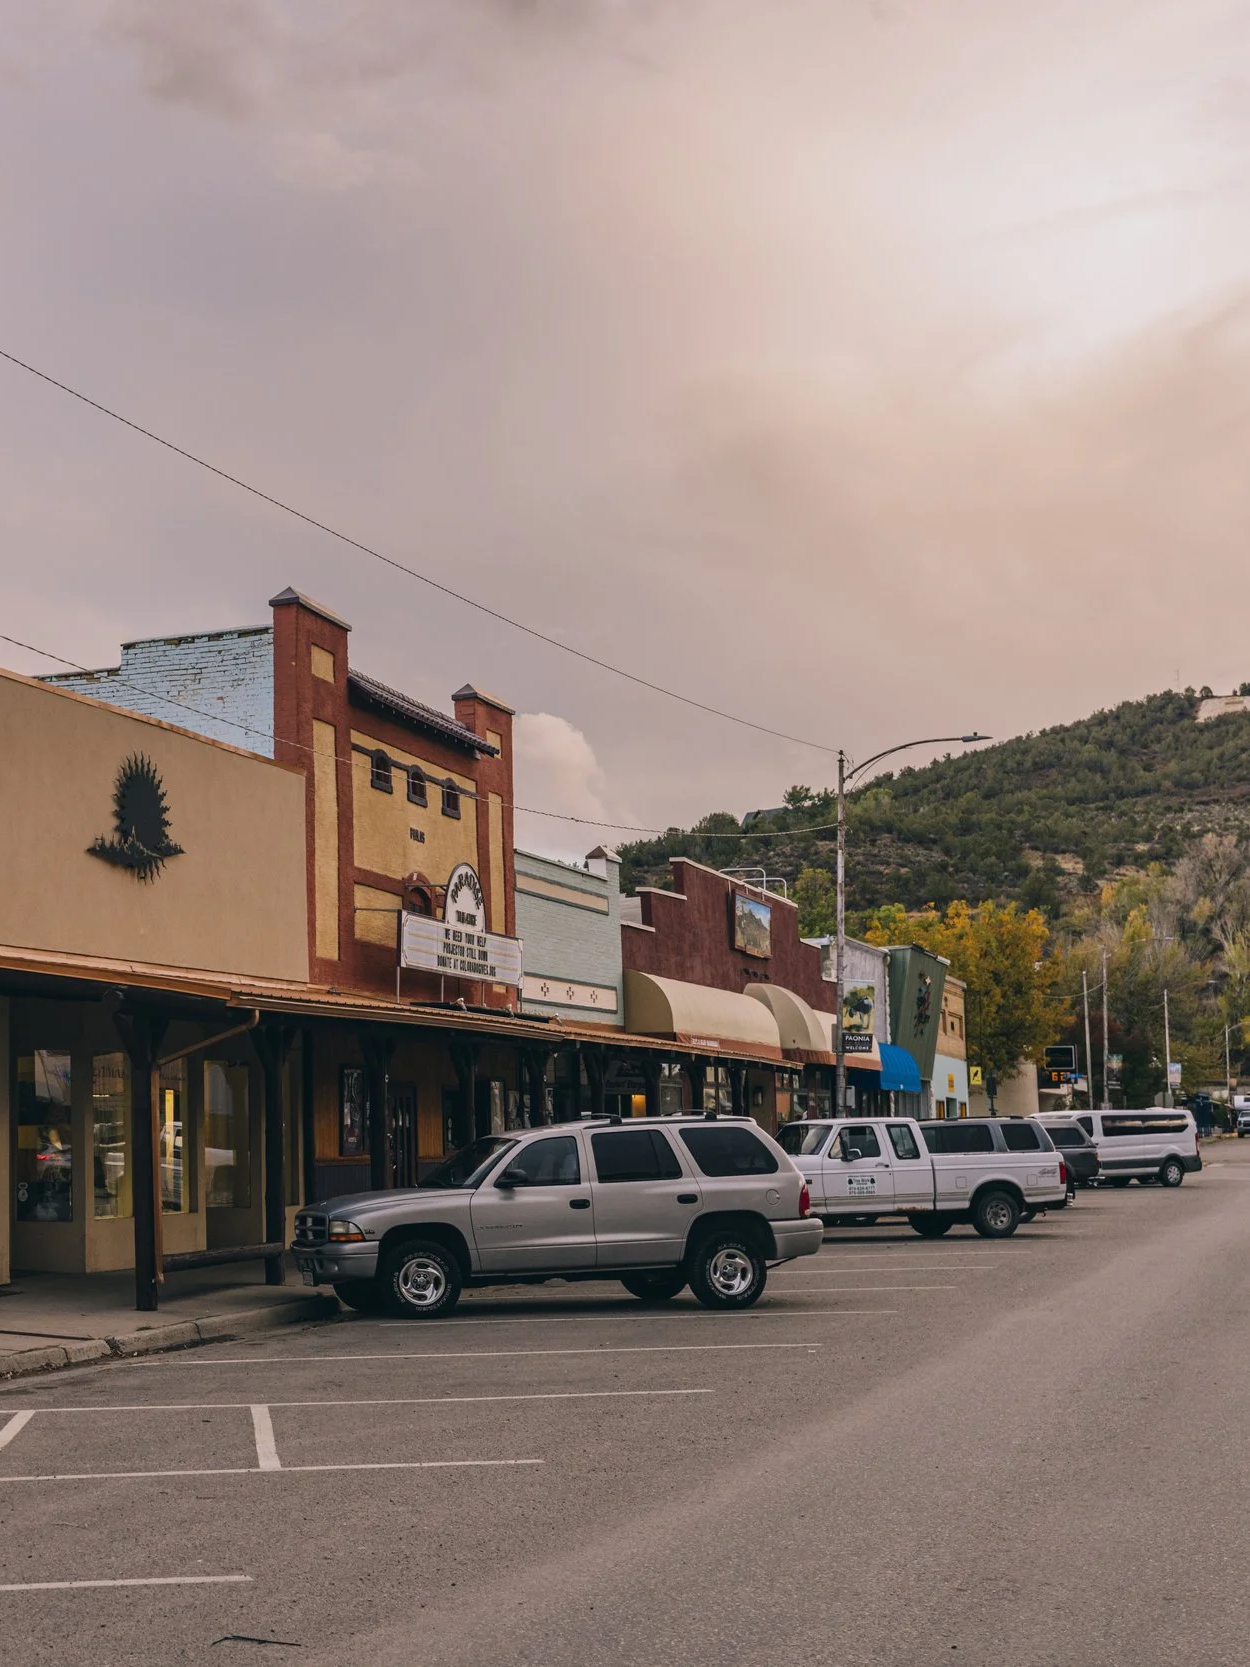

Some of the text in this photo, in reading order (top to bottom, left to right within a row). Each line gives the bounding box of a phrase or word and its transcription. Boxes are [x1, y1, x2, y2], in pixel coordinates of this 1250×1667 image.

[451, 872, 484, 910] PARADISE
[453, 930, 462, 942] NEED
[477, 935, 486, 948] HELP
[437, 955, 452, 969] DONATE
[467, 947, 476, 960] STILL
[478, 949, 488, 962] DOWN
